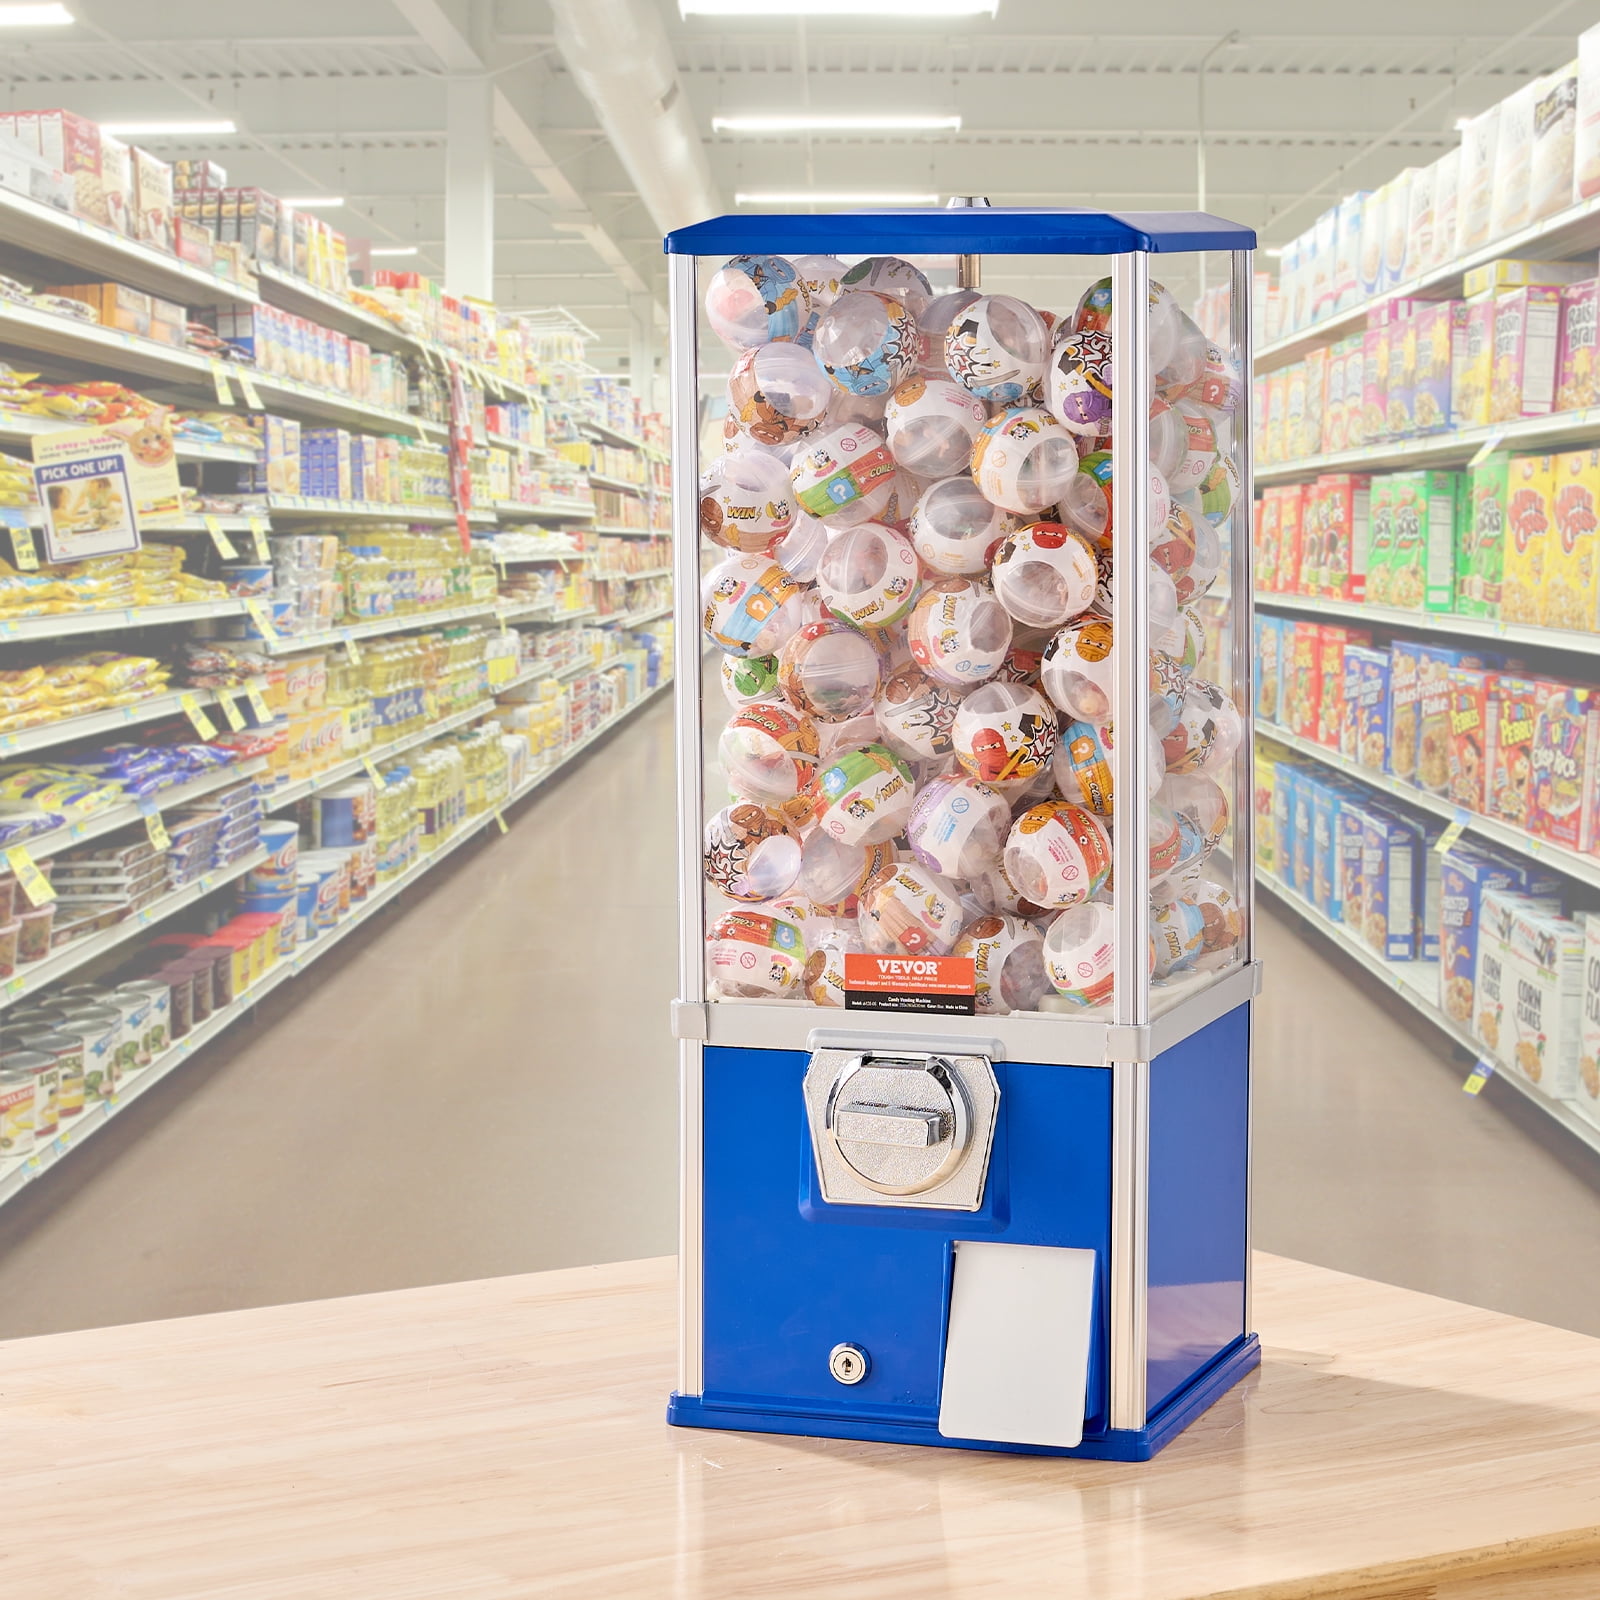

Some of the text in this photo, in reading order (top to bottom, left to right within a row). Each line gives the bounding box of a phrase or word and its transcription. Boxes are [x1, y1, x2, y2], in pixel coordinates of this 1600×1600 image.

[1084, 337, 1110, 366] VS
[41, 458, 119, 481] PICK ONE UP!
[727, 505, 757, 520] WIN
[851, 600, 880, 620] WIN
[943, 594, 957, 621] WIN
[763, 720, 780, 731] ON
[1034, 729, 1056, 756] VS
[880, 775, 904, 801] WIN
[895, 873, 924, 893] WIN
[976, 942, 991, 971] WIN
[1164, 931, 1182, 958] WIN
[877, 959, 938, 975] VEVOR
[1588, 956, 1600, 991] CO
[1518, 979, 1542, 1012] CORN
[1517, 1001, 1542, 1032] FLAKES
